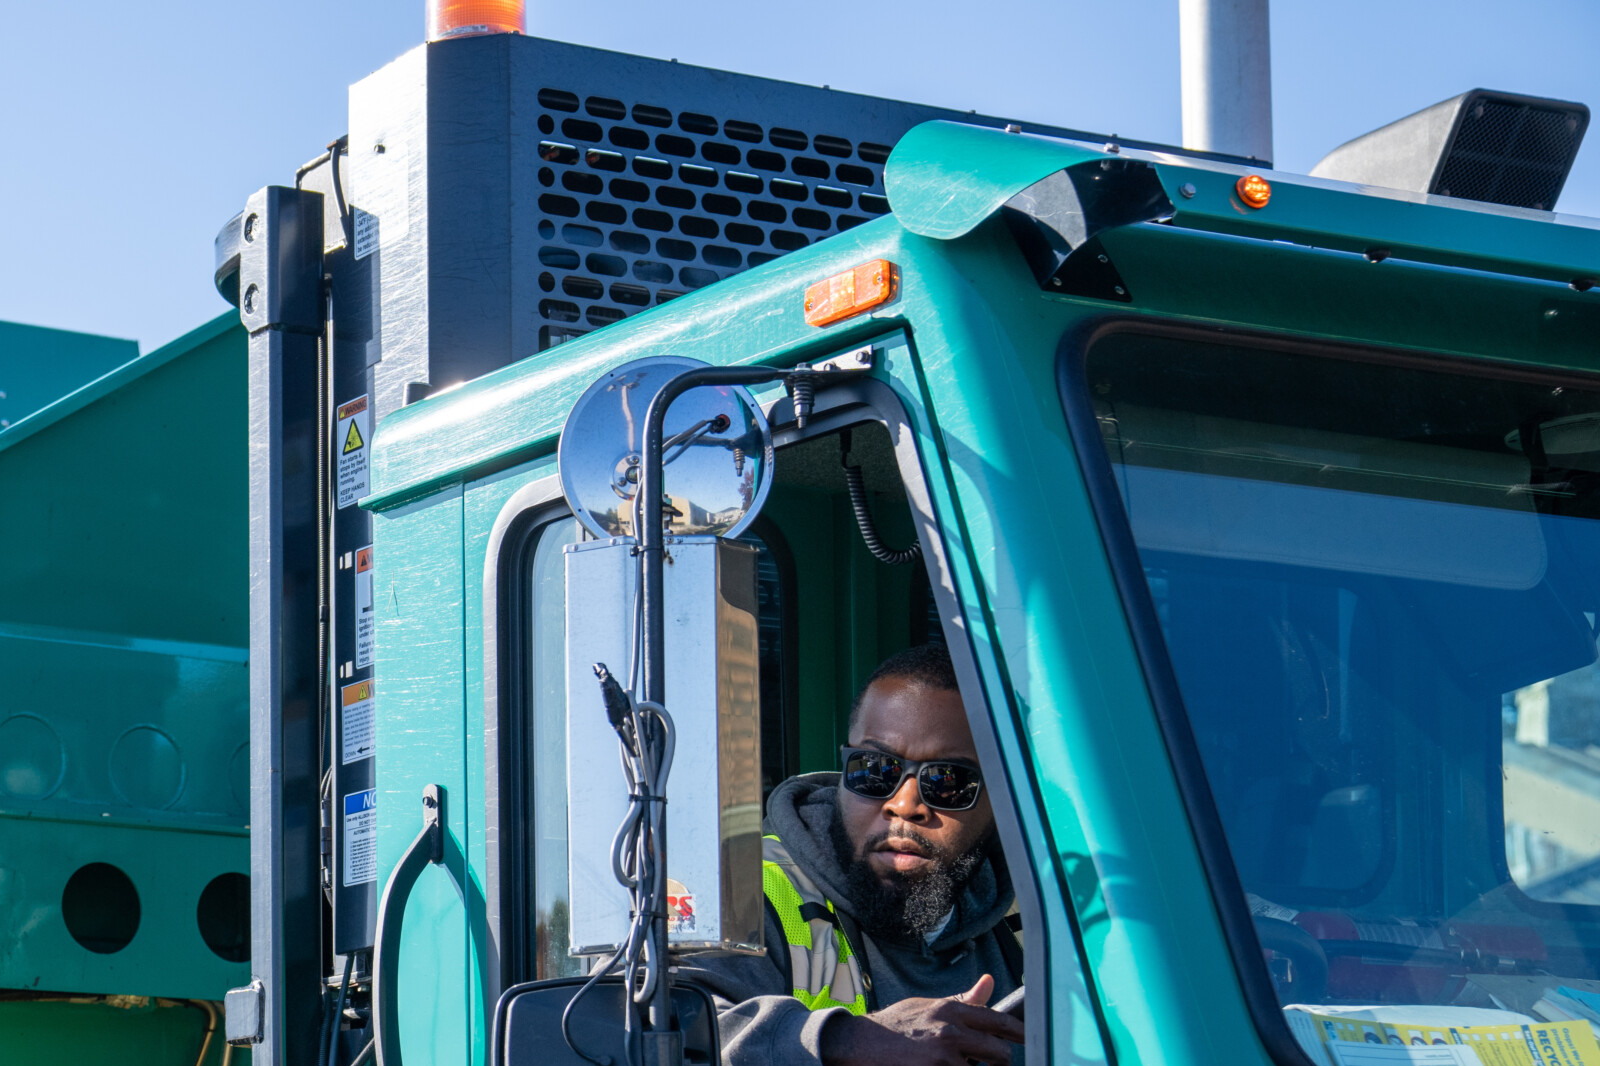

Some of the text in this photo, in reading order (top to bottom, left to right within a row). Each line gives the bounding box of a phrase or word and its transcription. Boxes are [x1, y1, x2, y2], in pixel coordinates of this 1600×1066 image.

[345, 399, 367, 415] WARNING
[351, 467, 363, 476] engine
[340, 482, 365, 496] KEEP HANDS
[340, 494, 354, 503] CLEAR
[345, 750, 357, 759] DOWN
[1550, 1028, 1568, 1059] problem
